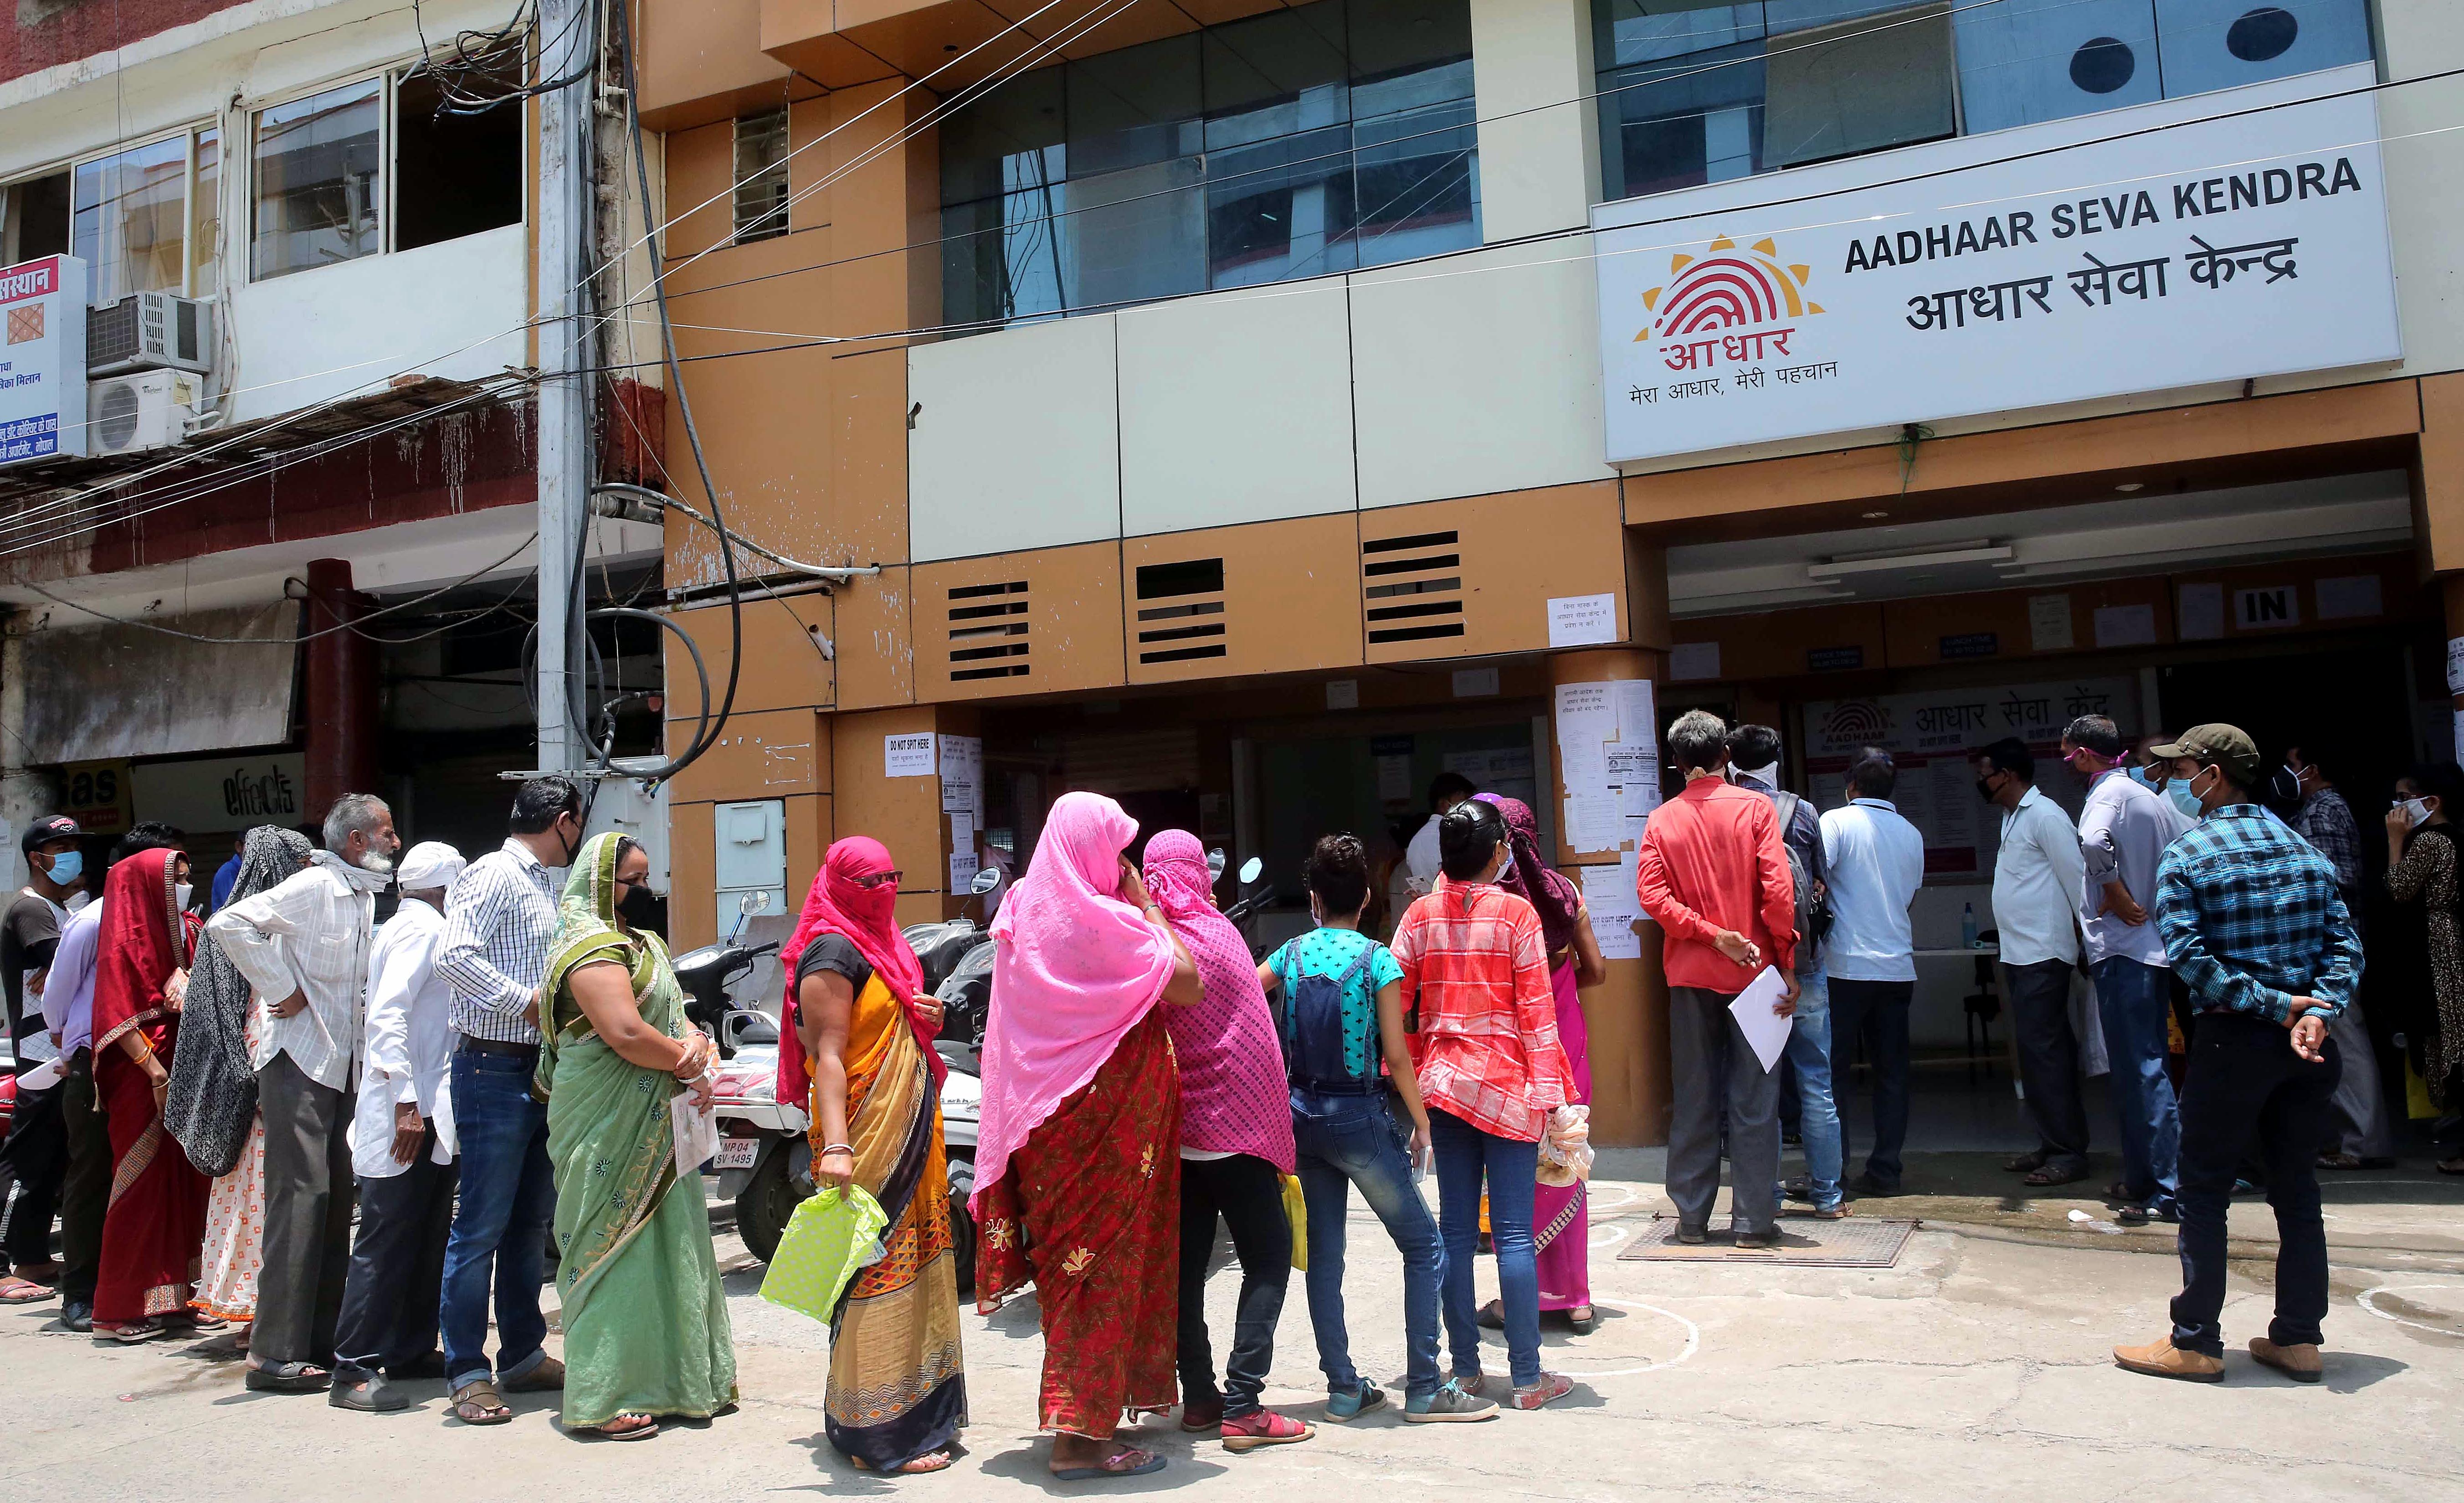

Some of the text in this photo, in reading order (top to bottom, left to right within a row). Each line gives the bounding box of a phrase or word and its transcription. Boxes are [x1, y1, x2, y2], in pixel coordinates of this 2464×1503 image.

[1845, 158, 2361, 273] AADHAAR SEVA KENDRA
[1906, 235, 2298, 330] आधार सेवा केन्द्र
[1660, 328, 1795, 371] आधार
[16, 373, 41, 386] मिलान
[1629, 362, 1838, 405] मेरा आधार, मेरी पहचान
[2246, 591, 2287, 622] IN
[1916, 704, 1986, 732] आधार
[2000, 690, 2050, 727] सेवा
[891, 738, 929, 751] DO NOT SPIT HERE
[1827, 731, 1884, 743] AADHAAR
[59, 766, 117, 806] as
